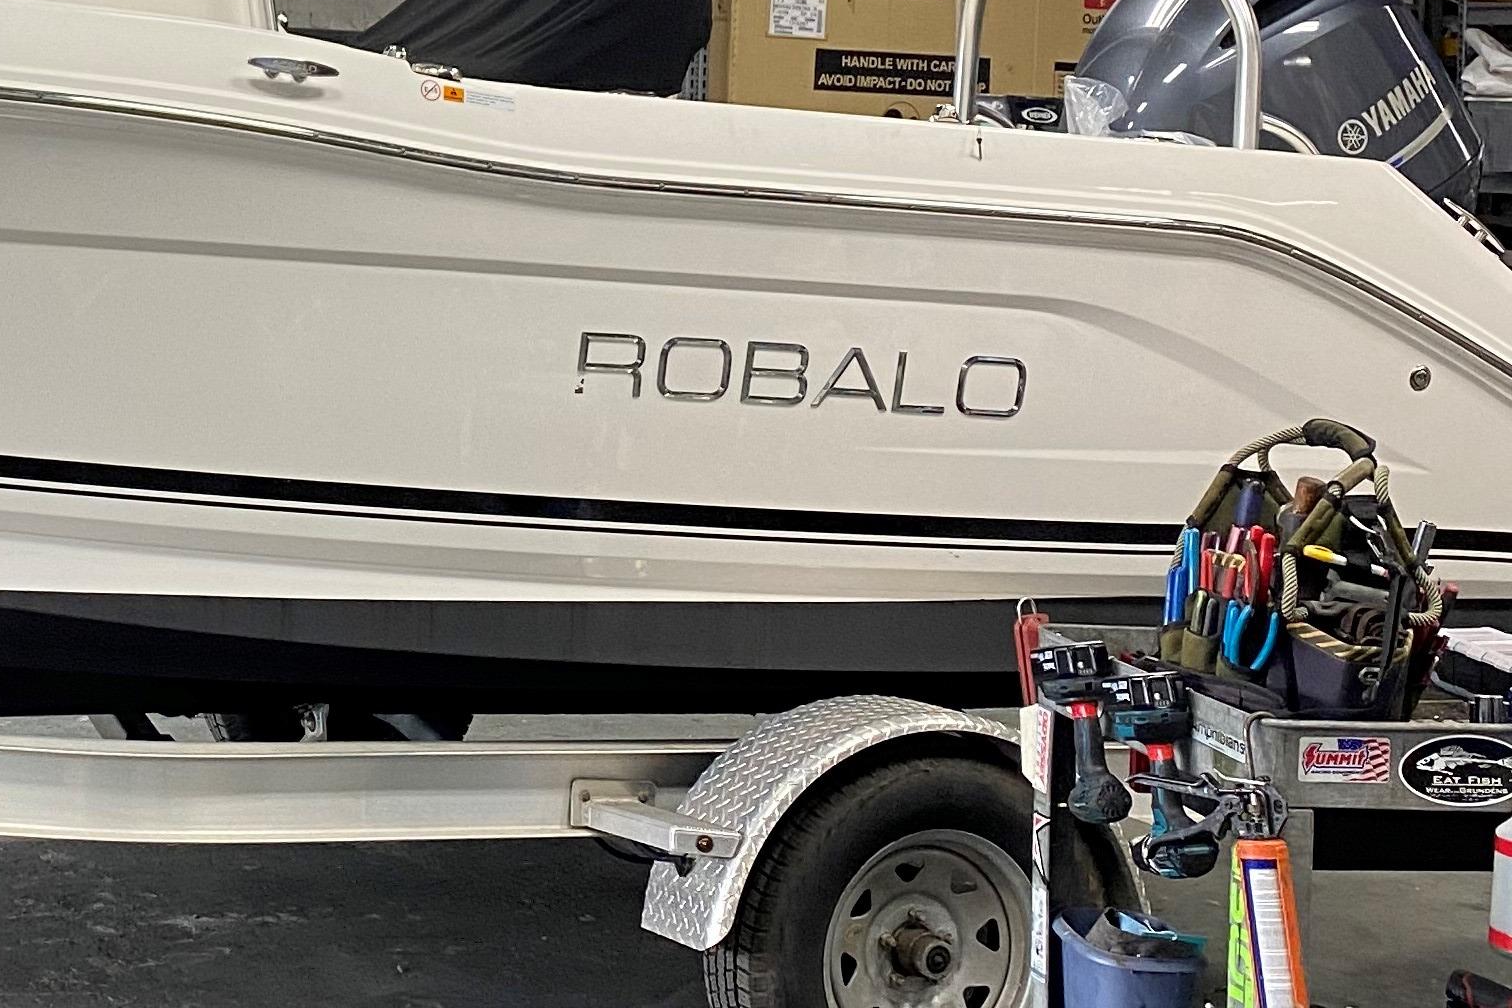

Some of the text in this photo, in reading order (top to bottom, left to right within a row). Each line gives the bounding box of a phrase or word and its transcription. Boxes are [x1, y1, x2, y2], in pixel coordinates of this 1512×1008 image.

[841, 54, 956, 73] HANDLE WITH CAR
[818, 73, 855, 87] AVOID
[927, 80, 952, 93] NOT
[1361, 60, 1436, 137] YAMAHA
[574, 331, 1027, 418] ROBALO
[1302, 743, 1369, 775] SUMMIT
[1433, 775, 1502, 785] EAT FISH
